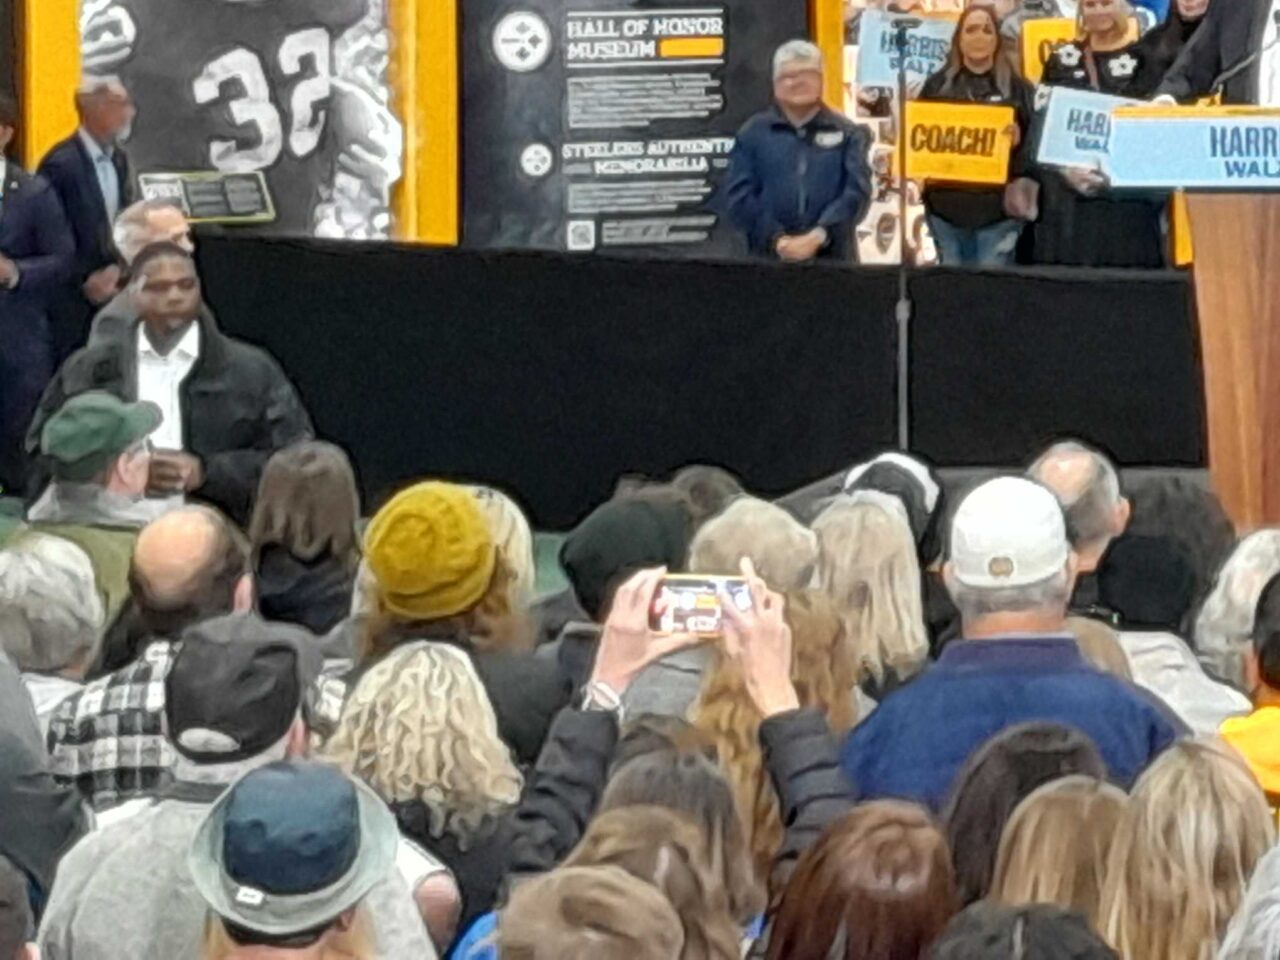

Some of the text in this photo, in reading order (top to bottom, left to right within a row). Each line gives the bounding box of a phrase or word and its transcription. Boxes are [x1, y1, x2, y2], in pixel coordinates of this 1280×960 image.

[622, 18, 649, 37] OF
[193, 27, 331, 172] 32
[911, 124, 996, 157] COACH!
